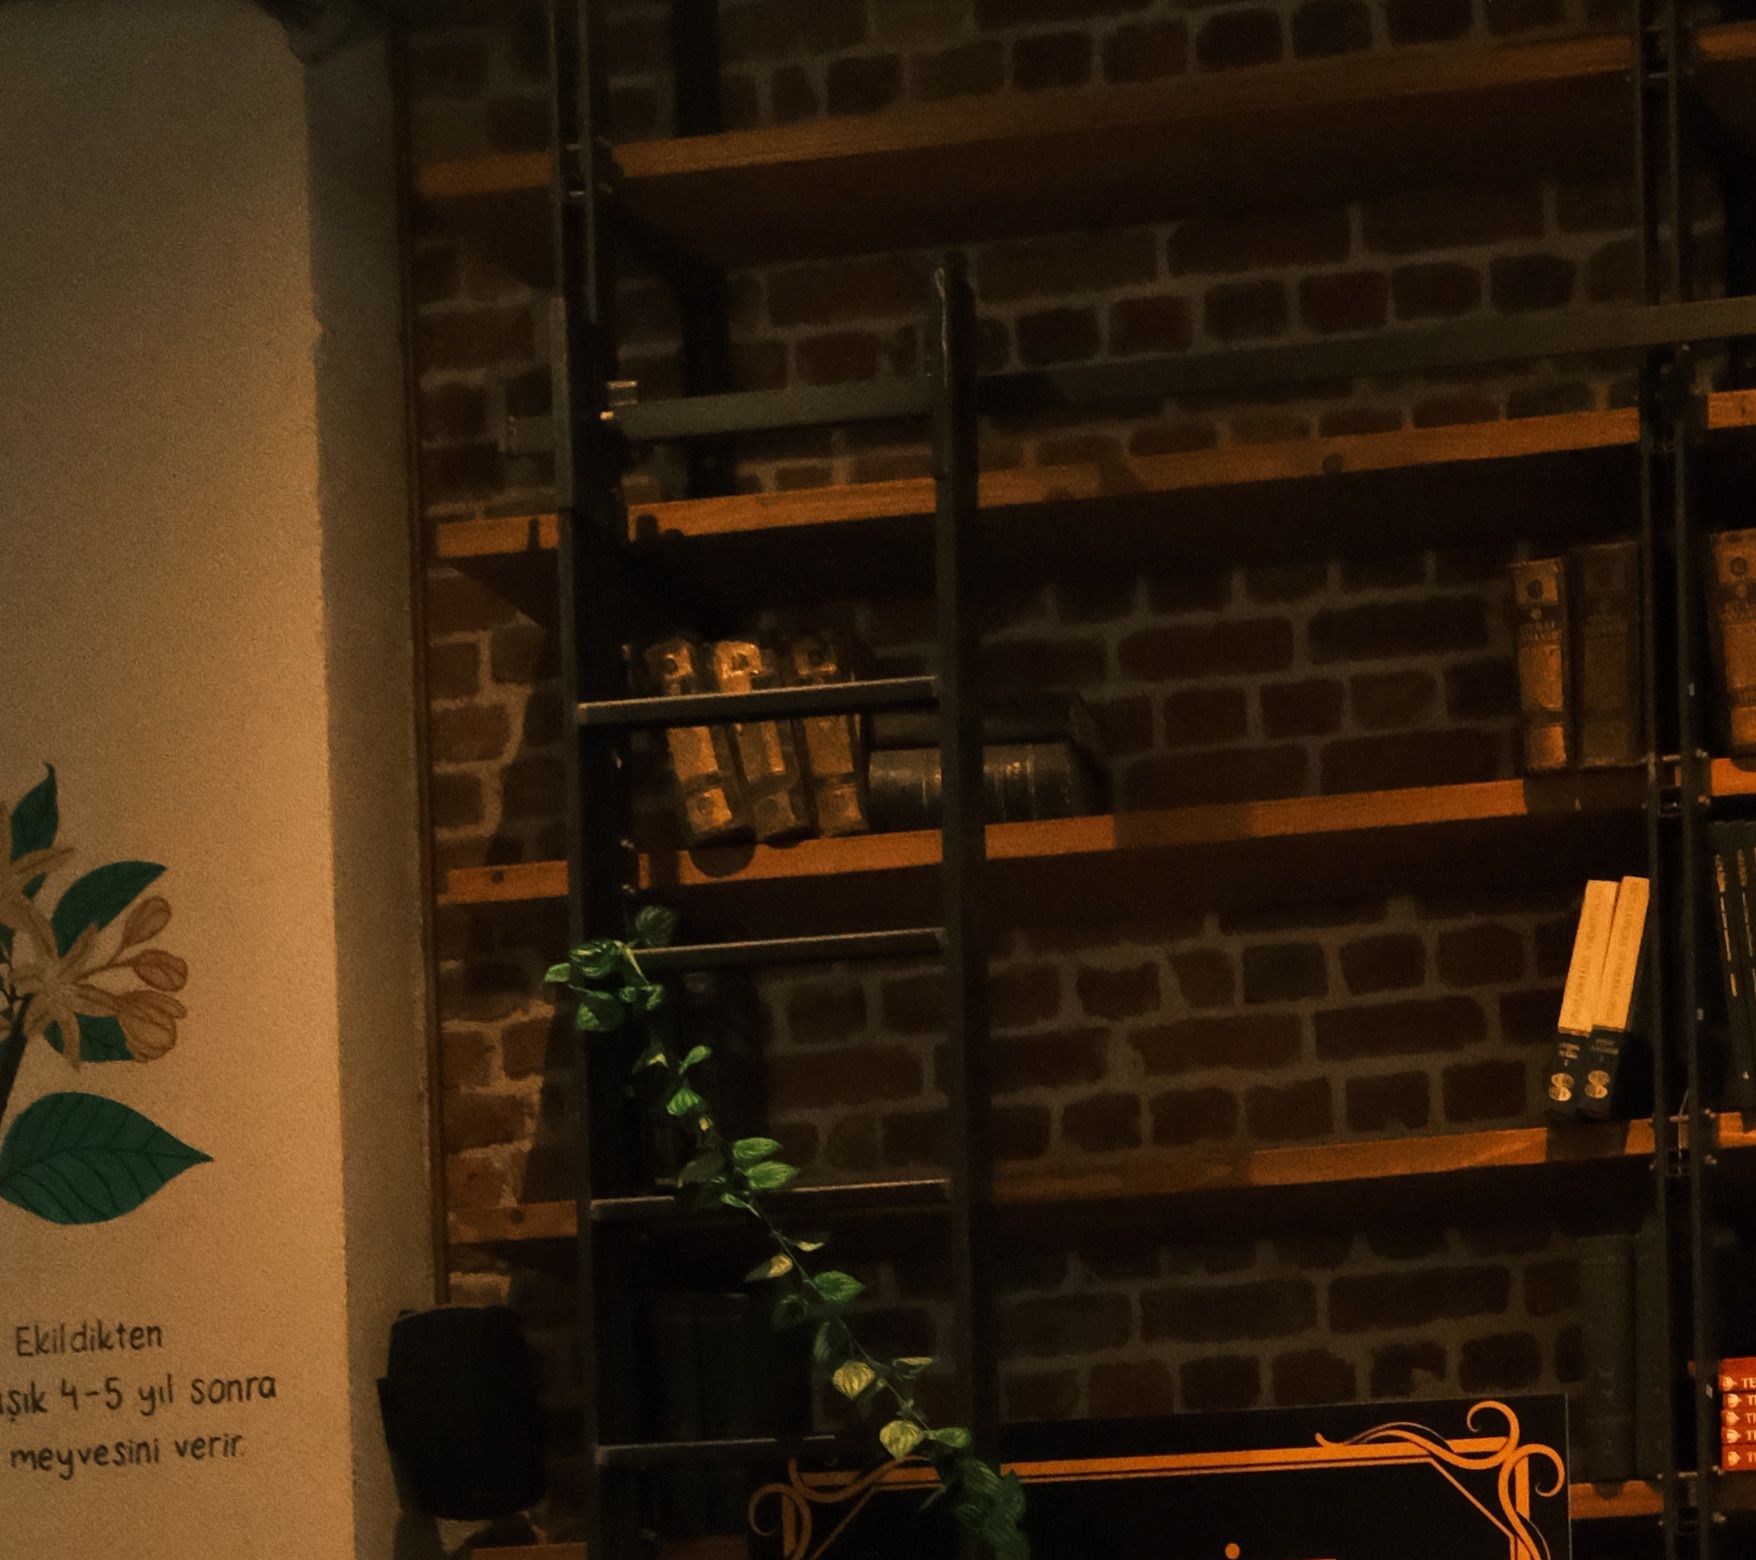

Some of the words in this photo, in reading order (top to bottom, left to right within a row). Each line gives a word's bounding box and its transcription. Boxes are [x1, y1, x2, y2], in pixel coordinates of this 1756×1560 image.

[15, 1320, 163, 1357] Ekildikten
[0, 1380, 48, 1423] şık
[138, 1373, 174, 1417] yıl
[190, 1376, 276, 1405] sonra
[11, 1438, 160, 1481] meyvesini
